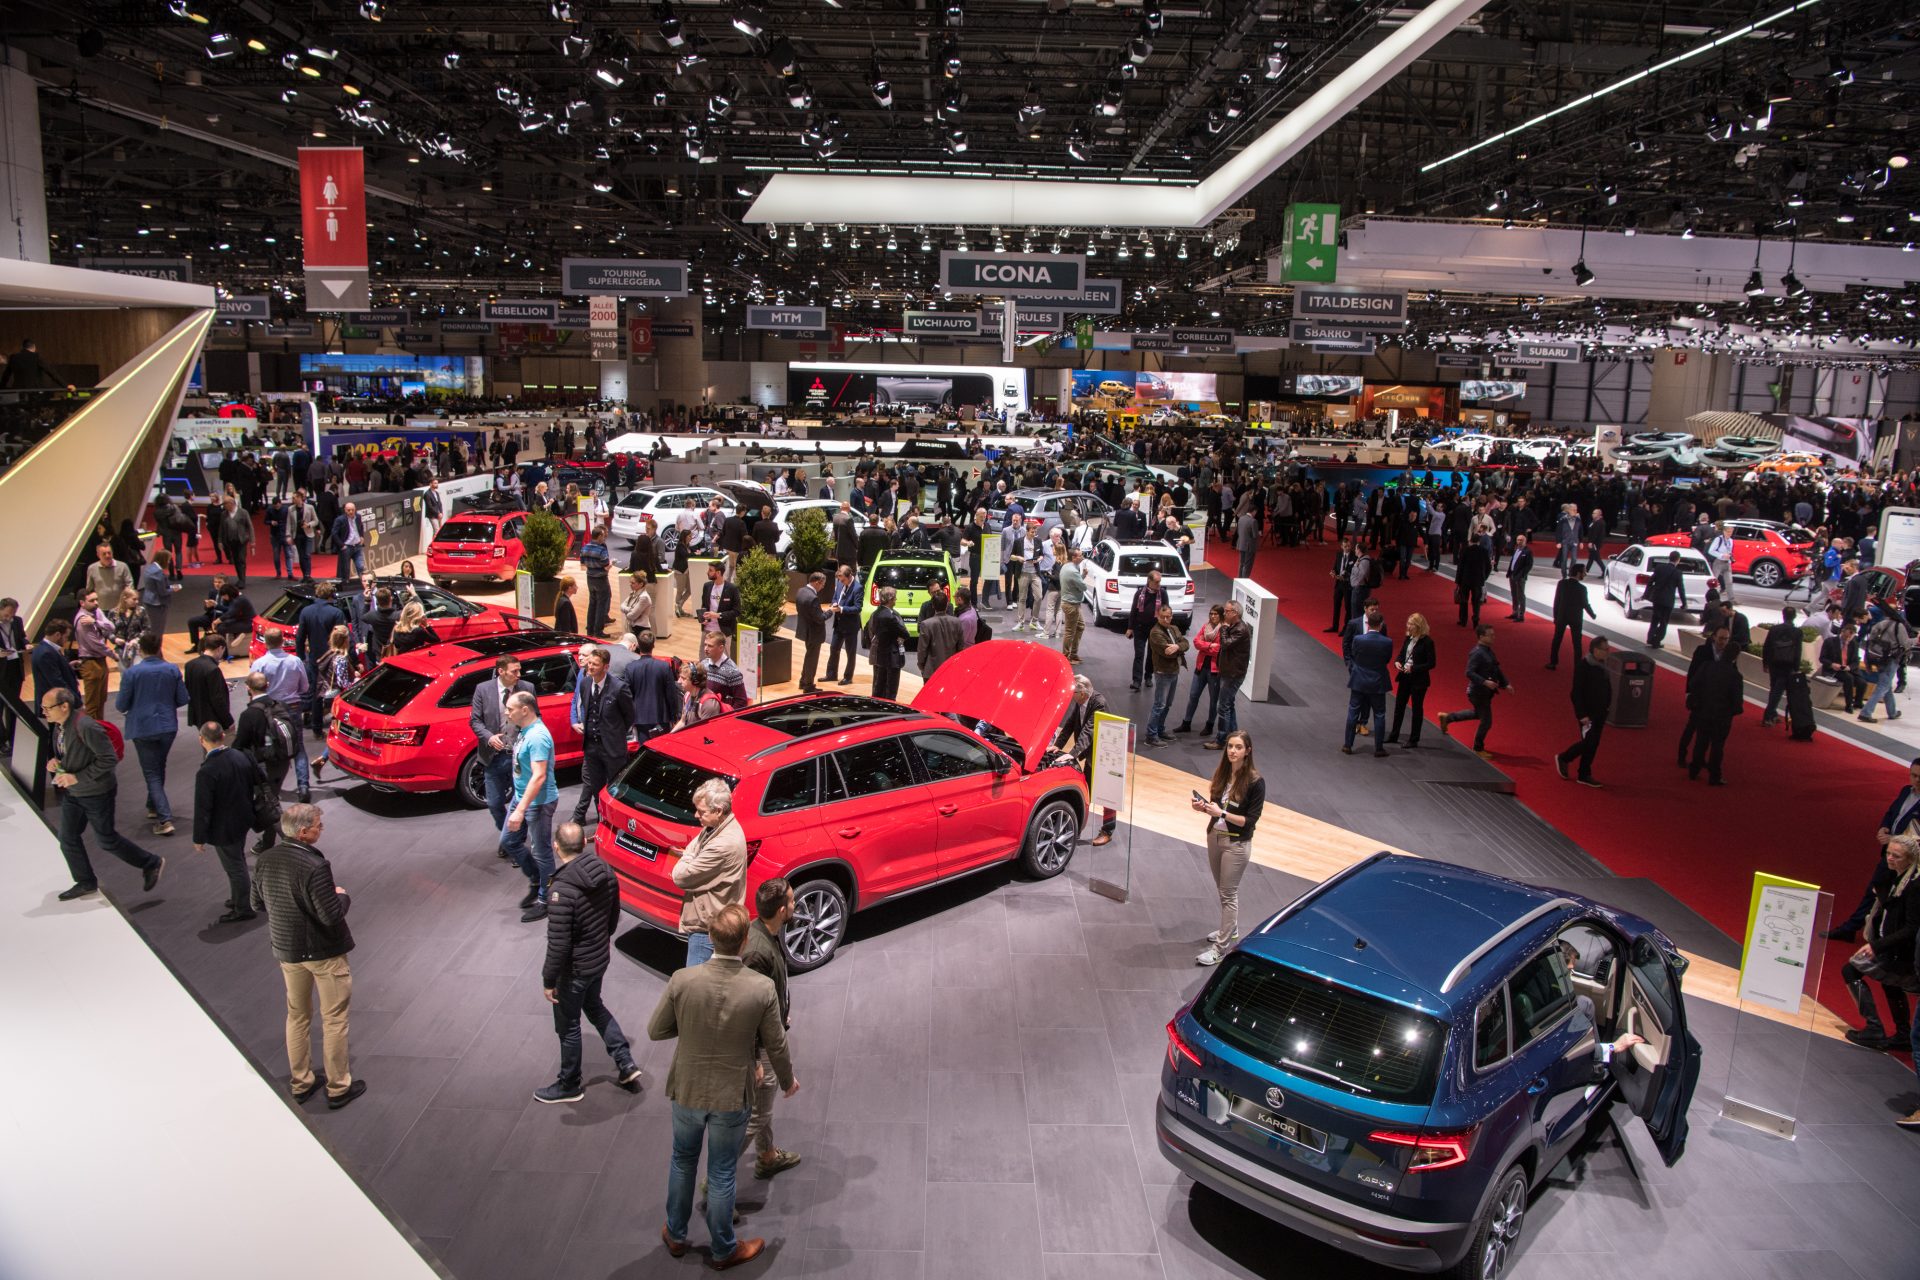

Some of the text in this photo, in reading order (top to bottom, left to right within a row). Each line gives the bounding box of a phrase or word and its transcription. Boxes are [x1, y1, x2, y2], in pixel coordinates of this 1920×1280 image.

[107, 269, 179, 281] DYEAR
[603, 269, 647, 278] TOURING
[975, 264, 1052, 284] ICONA
[588, 277, 662, 286] SUPERLEGGERA
[1309, 295, 1394, 310] ITALDESIGN
[491, 306, 548, 316] REBELLION
[590, 311, 617, 321] 2000
[771, 312, 802, 323] MTM
[988, 311, 1053, 323] TERULES
[943, 319, 972, 328] AUTO
[1176, 333, 1228, 342] CORBELLATI
[1529, 347, 1569, 357] SUBARU
[1257, 1112, 1296, 1136] KAROQ
[1357, 1173, 1394, 1191] KAROQ
